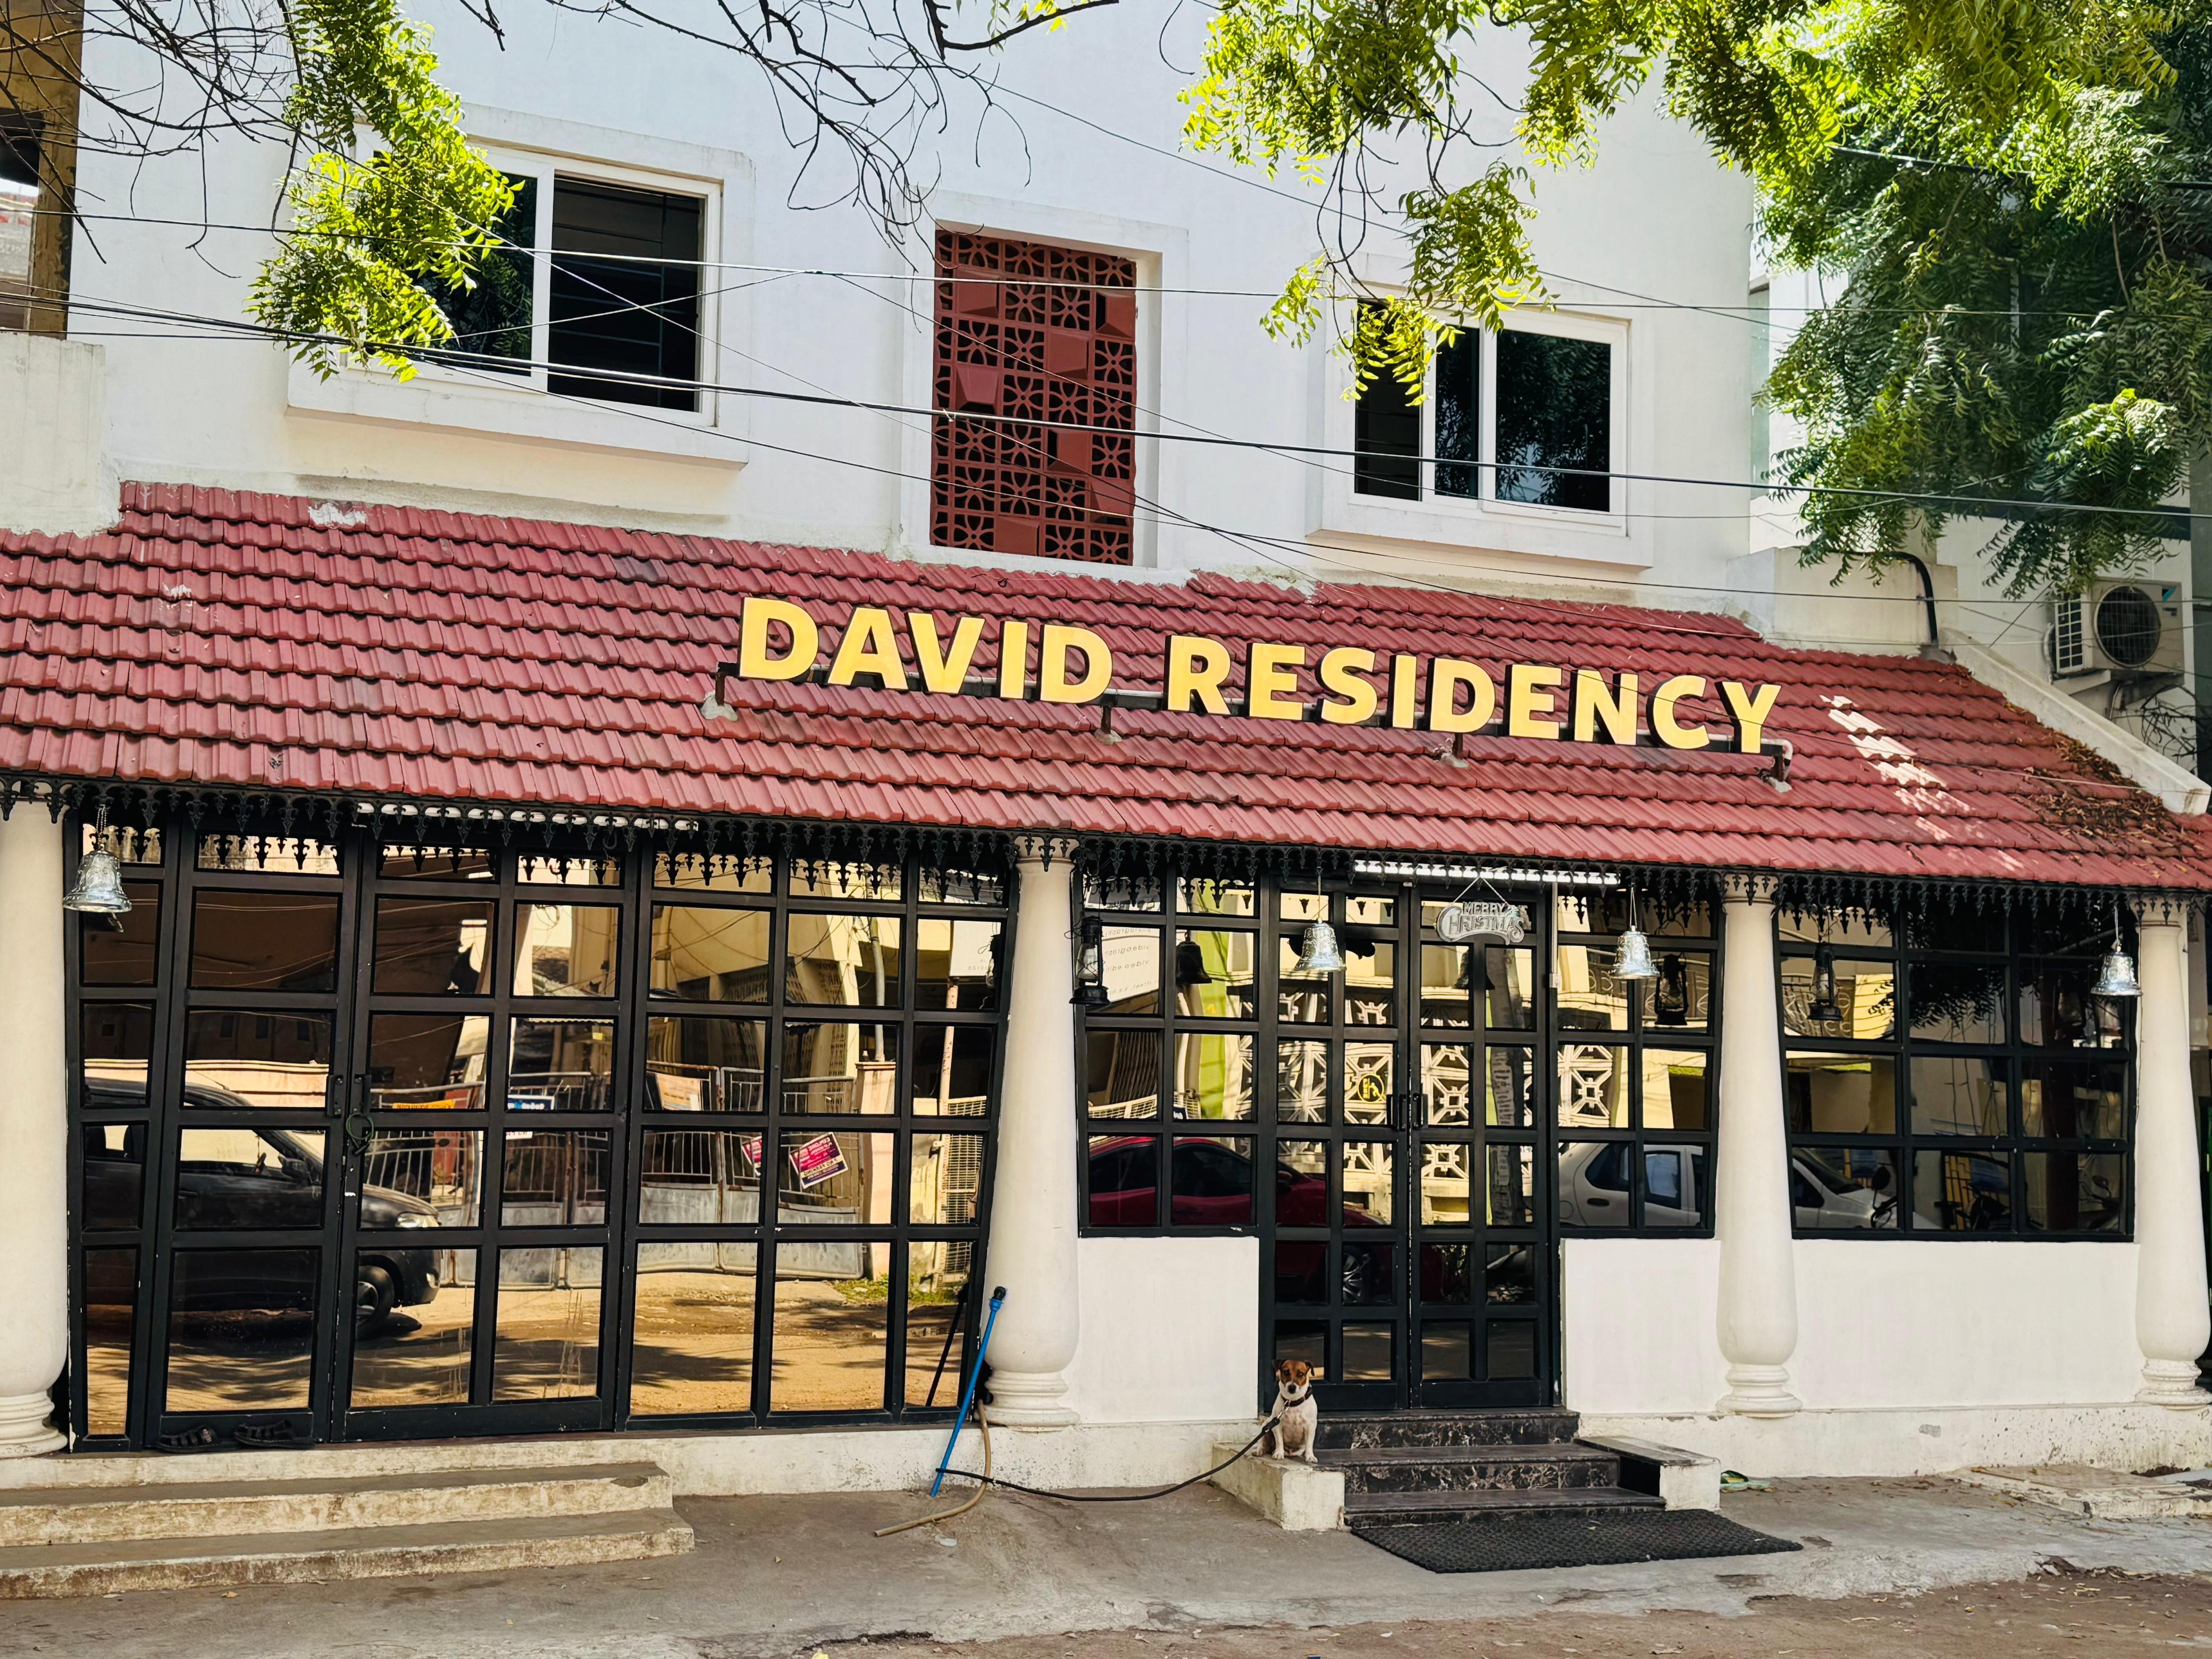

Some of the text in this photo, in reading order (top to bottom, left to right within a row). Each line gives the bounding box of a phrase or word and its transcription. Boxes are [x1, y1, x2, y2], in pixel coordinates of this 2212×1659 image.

[739, 596, 1781, 753] DAVID RESIDENCY
[1437, 906, 1524, 945] CHRISTMAS
[1463, 901, 1505, 915] MERRY
